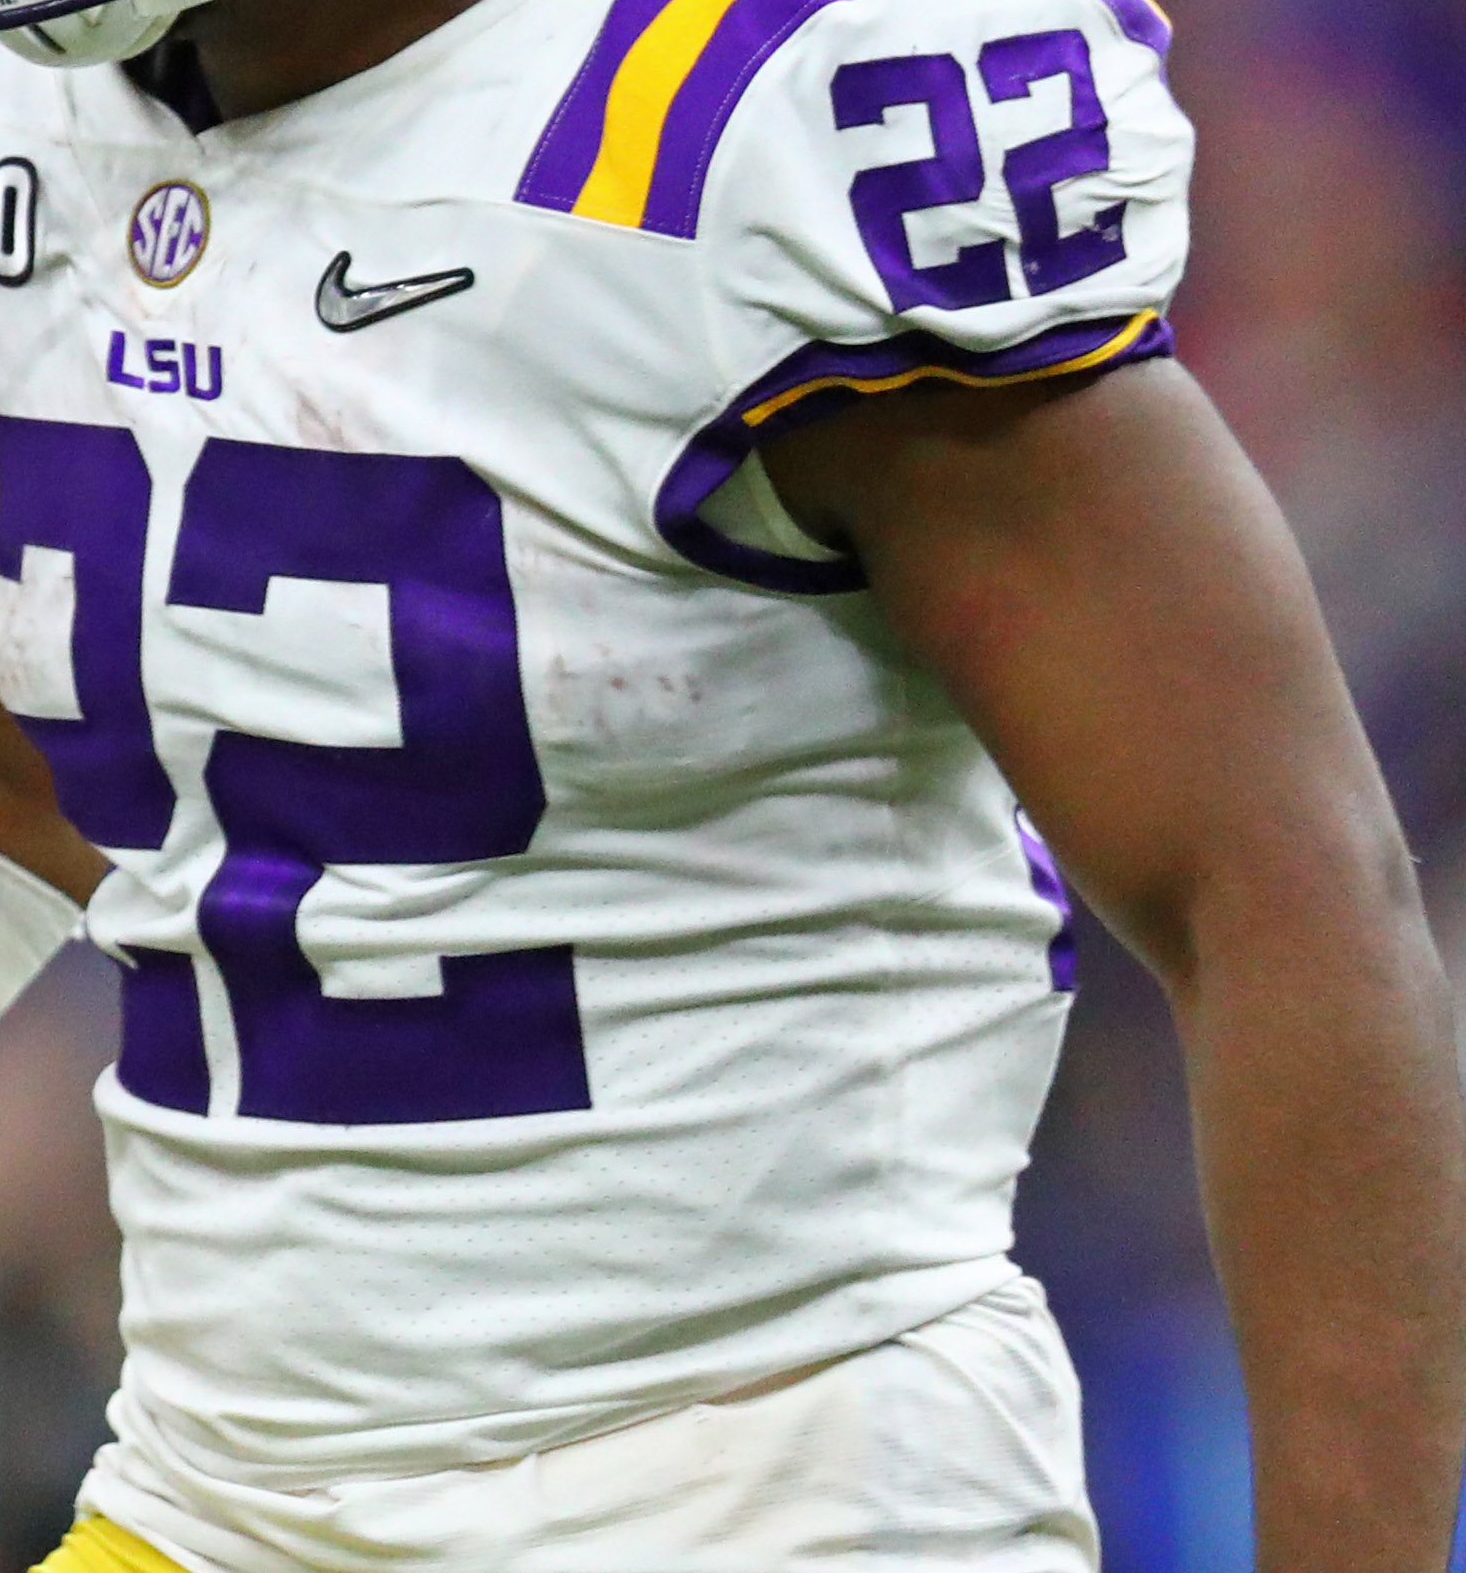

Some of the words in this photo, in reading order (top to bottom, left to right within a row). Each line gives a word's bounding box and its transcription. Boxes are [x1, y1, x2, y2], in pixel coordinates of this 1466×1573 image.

[829, 28, 1129, 316] 22
[131, 185, 205, 280] SEC
[106, 330, 223, 401] LSU
